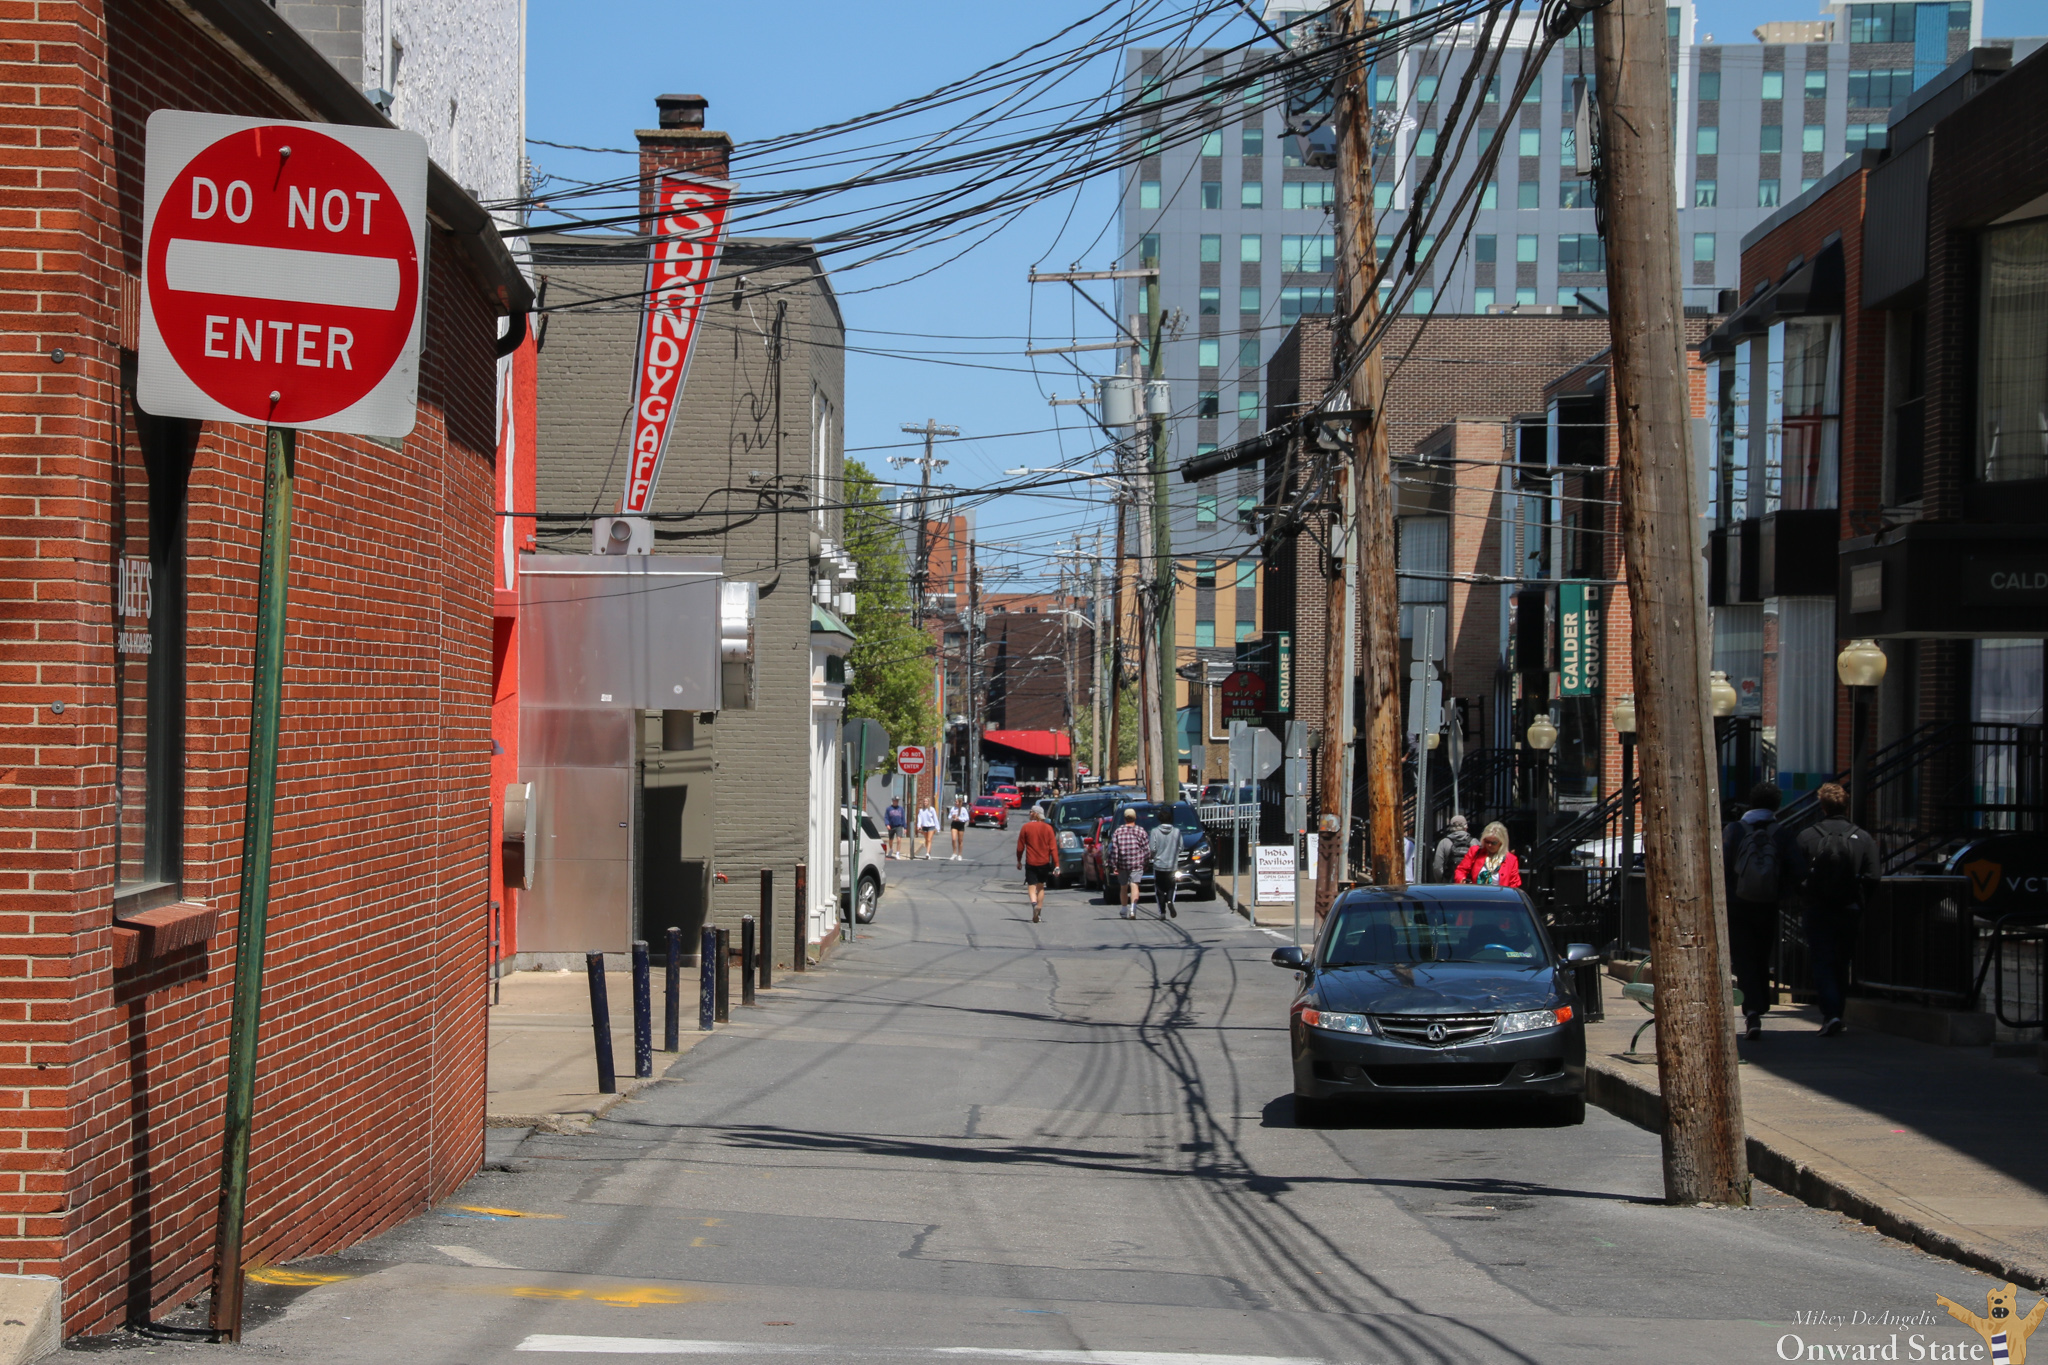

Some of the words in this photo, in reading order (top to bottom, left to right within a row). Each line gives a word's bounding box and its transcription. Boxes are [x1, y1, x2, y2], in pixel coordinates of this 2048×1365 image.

[191, 176, 254, 224] DO
[287, 185, 380, 235] NOT
[204, 314, 354, 371] ENTER
[630, 189, 715, 507] SHANDYGAFF
[1990, 571, 2048, 590] CALD
[1563, 611, 1579, 690] CALDER
[1584, 609, 1599, 688] SQUARE
[1280, 652, 1291, 708] SQUARE
[1232, 708, 1256, 717] LITTLE
[1259, 857, 1294, 866] Pavilion
[1265, 849, 1288, 857] India
